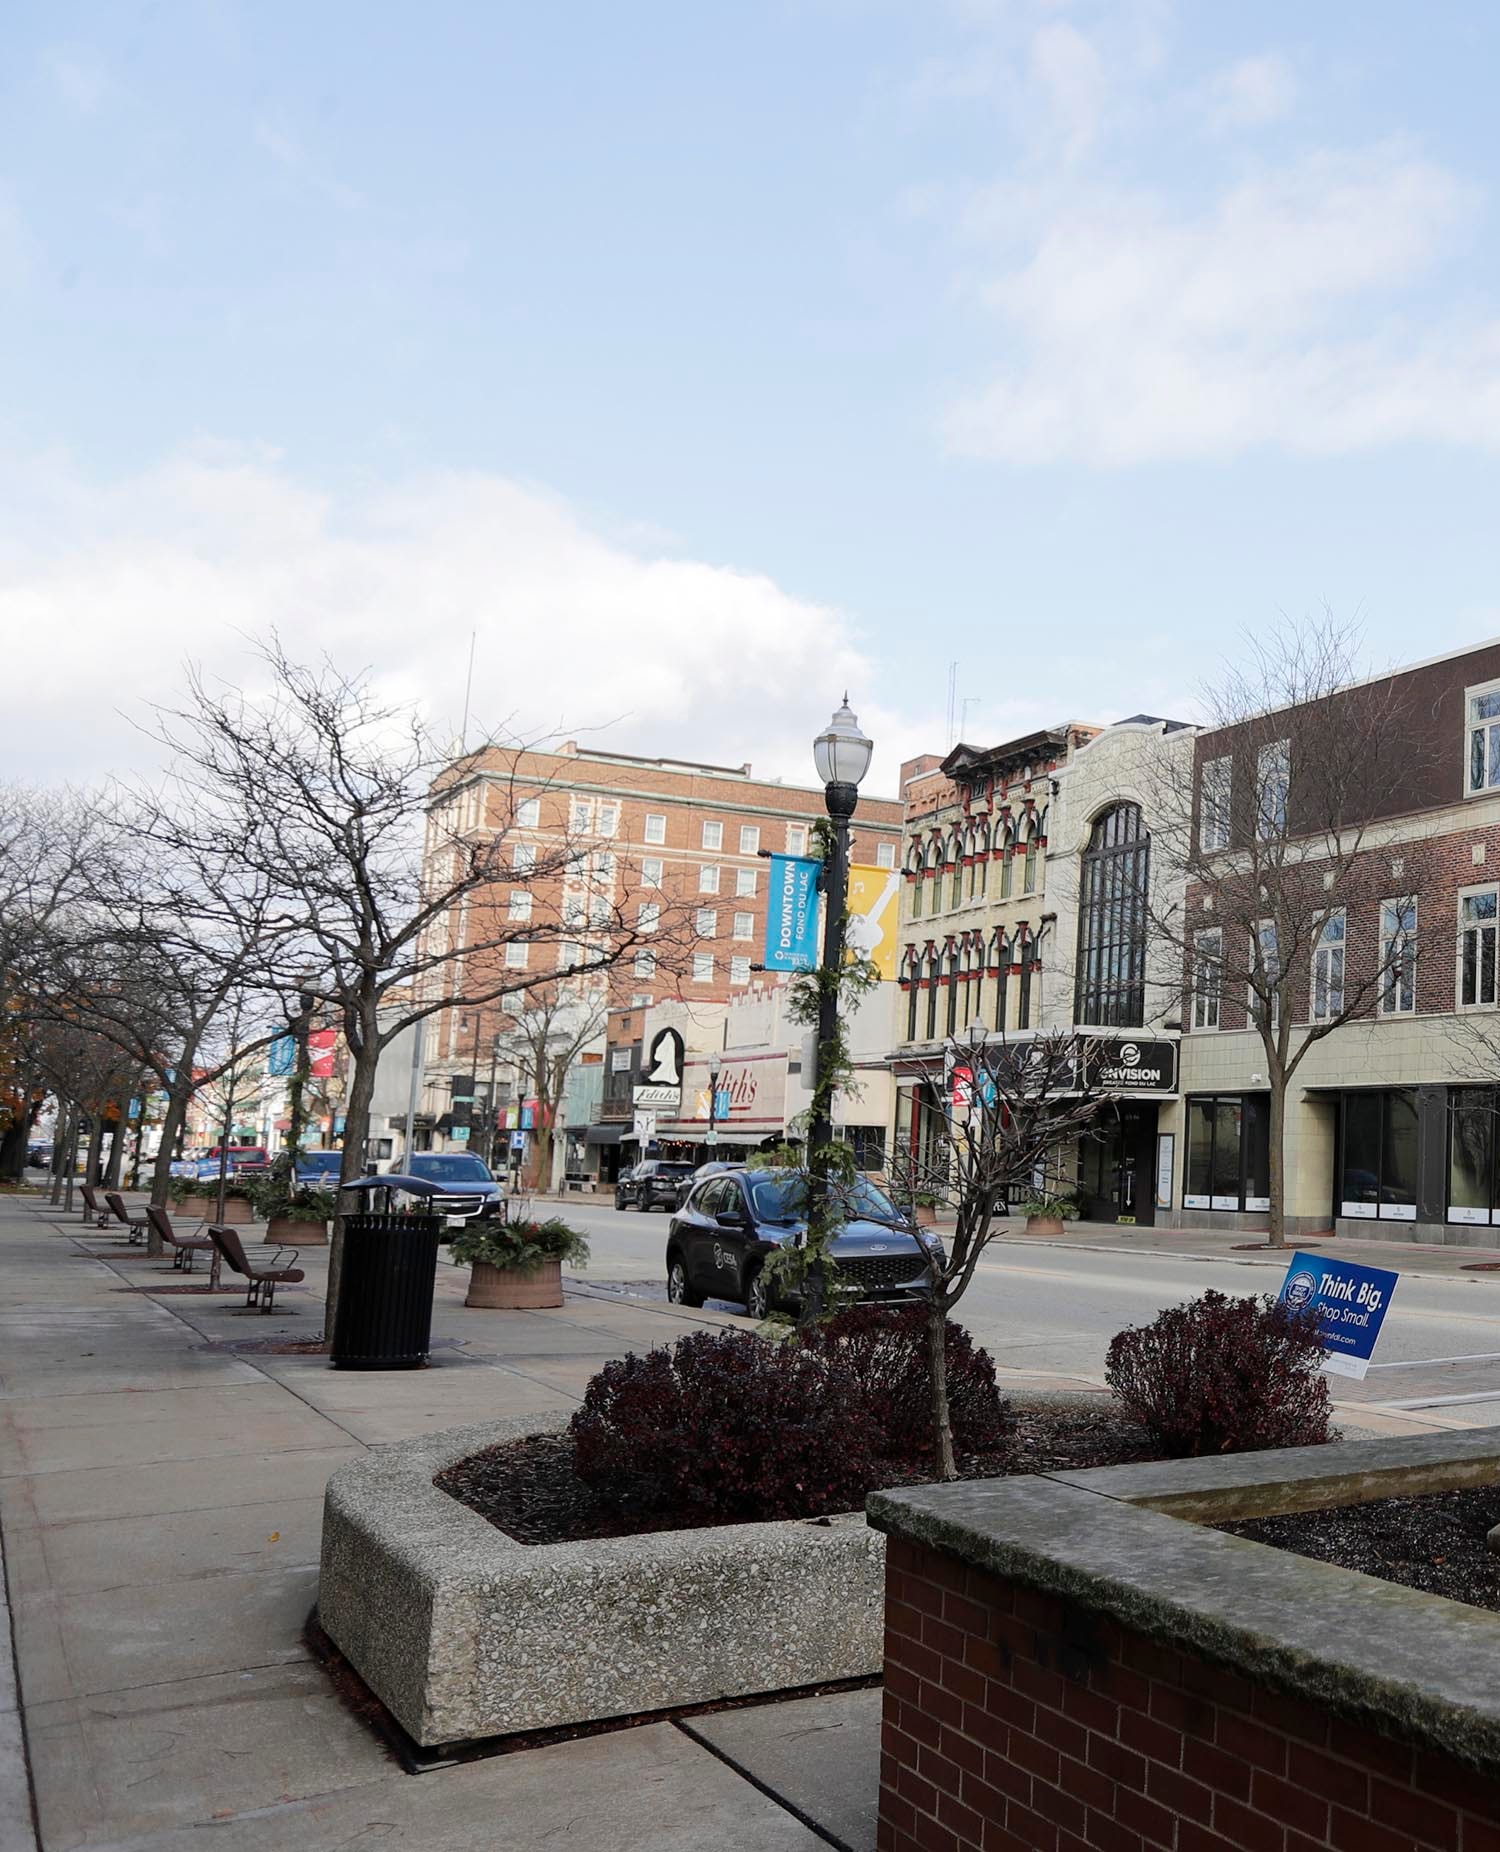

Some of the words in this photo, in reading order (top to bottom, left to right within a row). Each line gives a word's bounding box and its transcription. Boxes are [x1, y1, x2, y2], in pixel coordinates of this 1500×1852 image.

[800, 872, 809, 892] LAC
[780, 861, 796, 948] DOWNTOWN
[798, 893, 807, 909] DU
[796, 911, 805, 940] FOND
[636, 1087, 680, 1102] Edith's
[1318, 1273, 1356, 1302] Think
[1356, 1282, 1383, 1313] Big.
[1318, 1301, 1340, 1322] Shop
[1341, 1308, 1369, 1328] Small.
